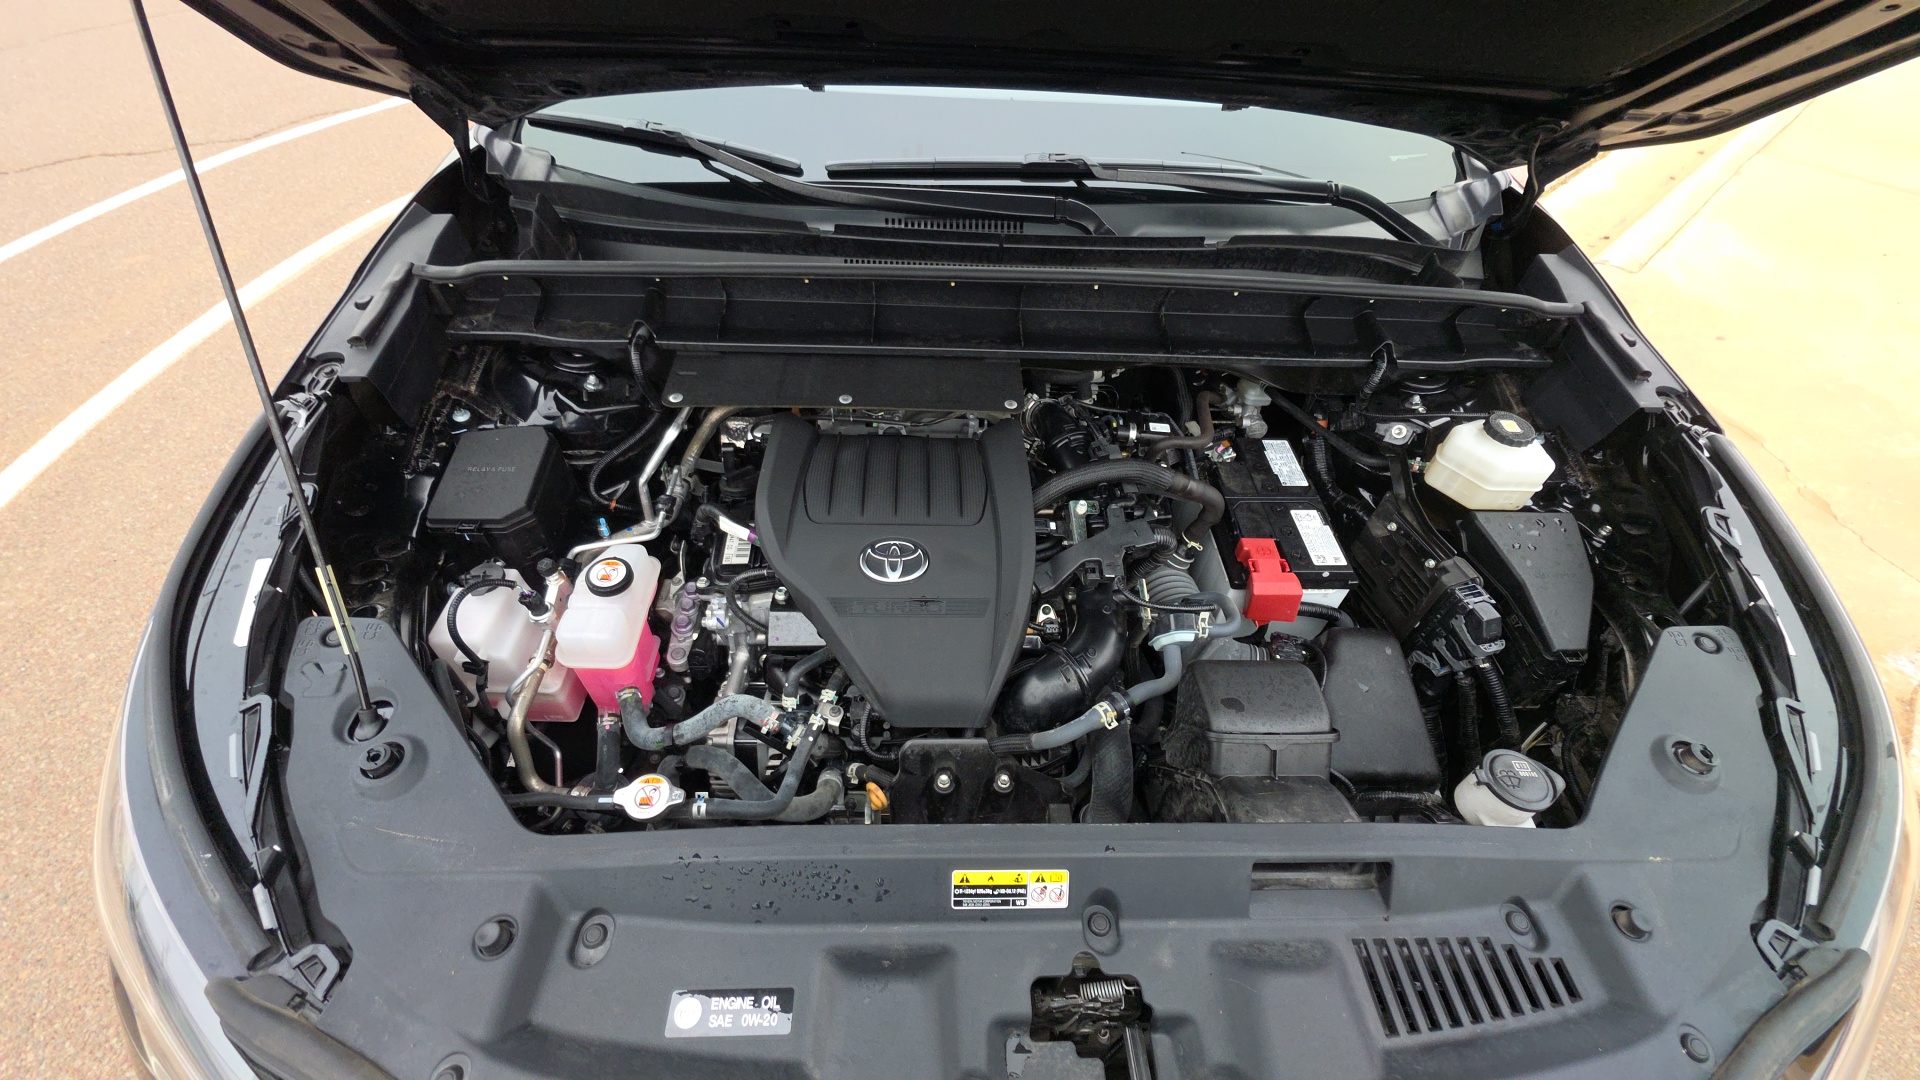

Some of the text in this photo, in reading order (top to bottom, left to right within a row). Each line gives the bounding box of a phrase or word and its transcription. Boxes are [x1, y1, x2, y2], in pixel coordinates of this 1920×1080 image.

[710, 995, 780, 1011] ENGINE OIL
[708, 1013, 778, 1028] SAE 0W-20
